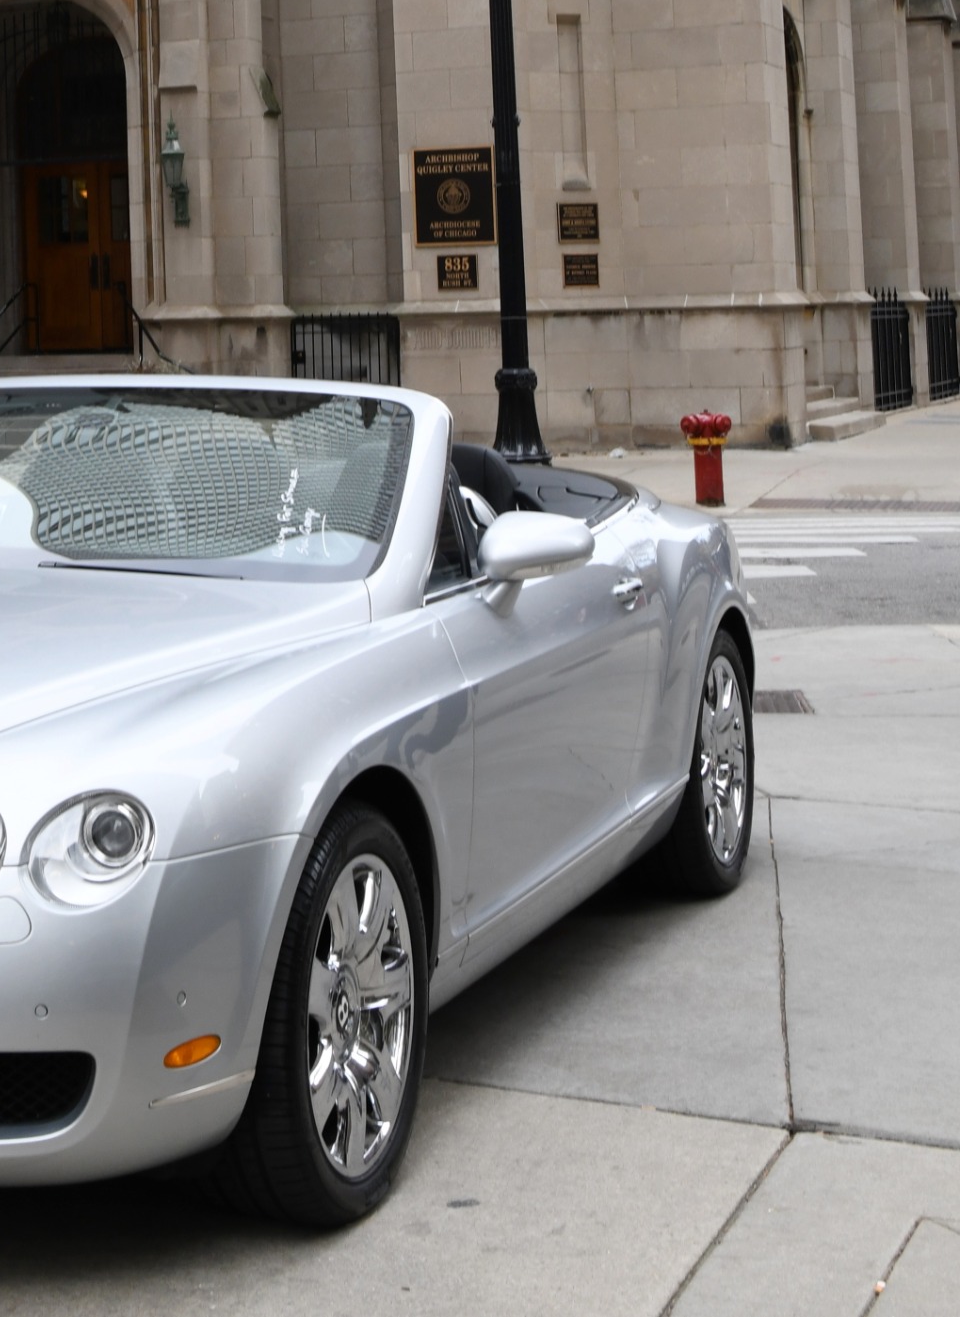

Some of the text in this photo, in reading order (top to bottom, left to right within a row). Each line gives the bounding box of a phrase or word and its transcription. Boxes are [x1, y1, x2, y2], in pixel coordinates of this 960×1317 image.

[425, 153, 479, 164] ARCHBISHOP
[417, 162, 488, 175] QUIGLEY CENTER
[429, 220, 480, 229] ARCHDIOCESE
[444, 229, 477, 238] CHICAGO
[444, 256, 469, 271] 835
